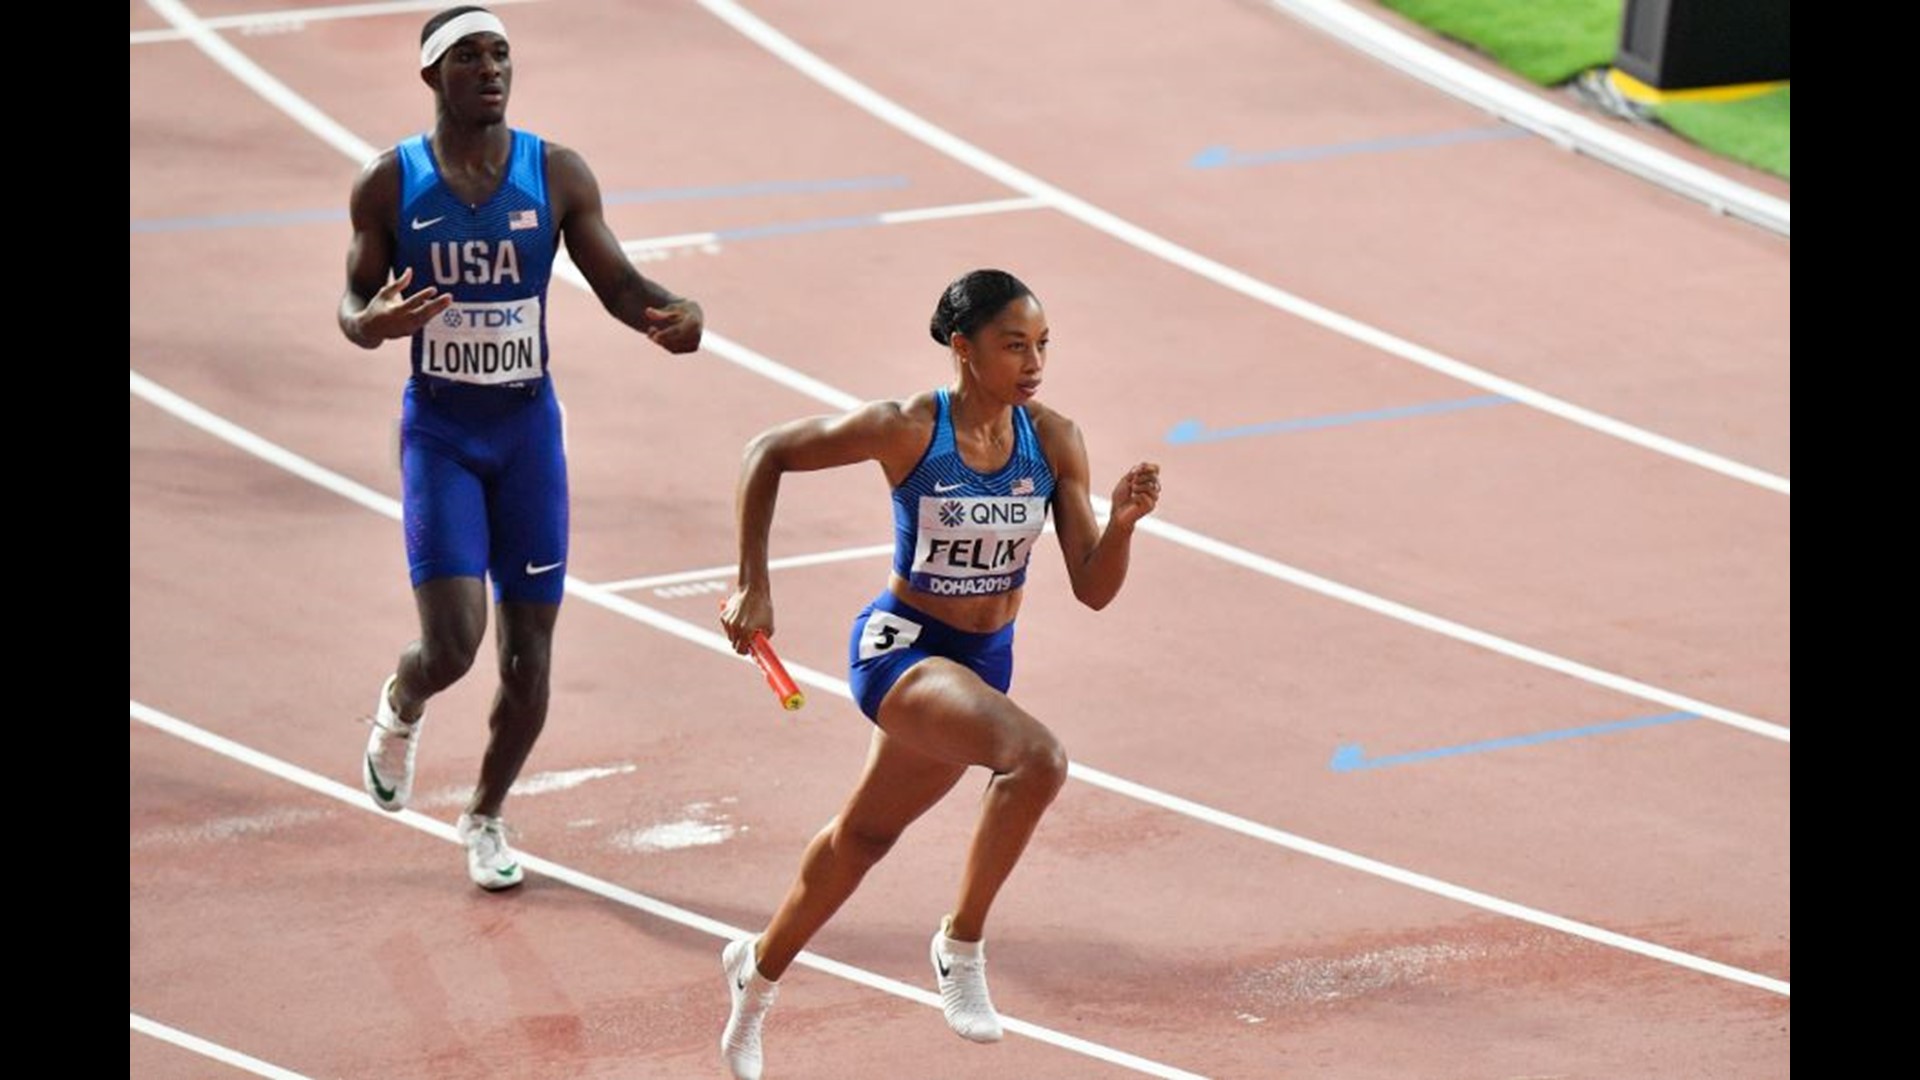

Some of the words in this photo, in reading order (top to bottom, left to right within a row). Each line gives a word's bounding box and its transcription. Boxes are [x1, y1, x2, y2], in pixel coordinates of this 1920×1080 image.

[431, 240, 521, 285] USA
[462, 306, 523, 328] TDK
[429, 337, 533, 374] LONDON
[971, 503, 1027, 524] QNB
[926, 538, 1026, 570] FELIX
[930, 577, 1011, 595] DOHA2019
[875, 625, 900, 650] 5
